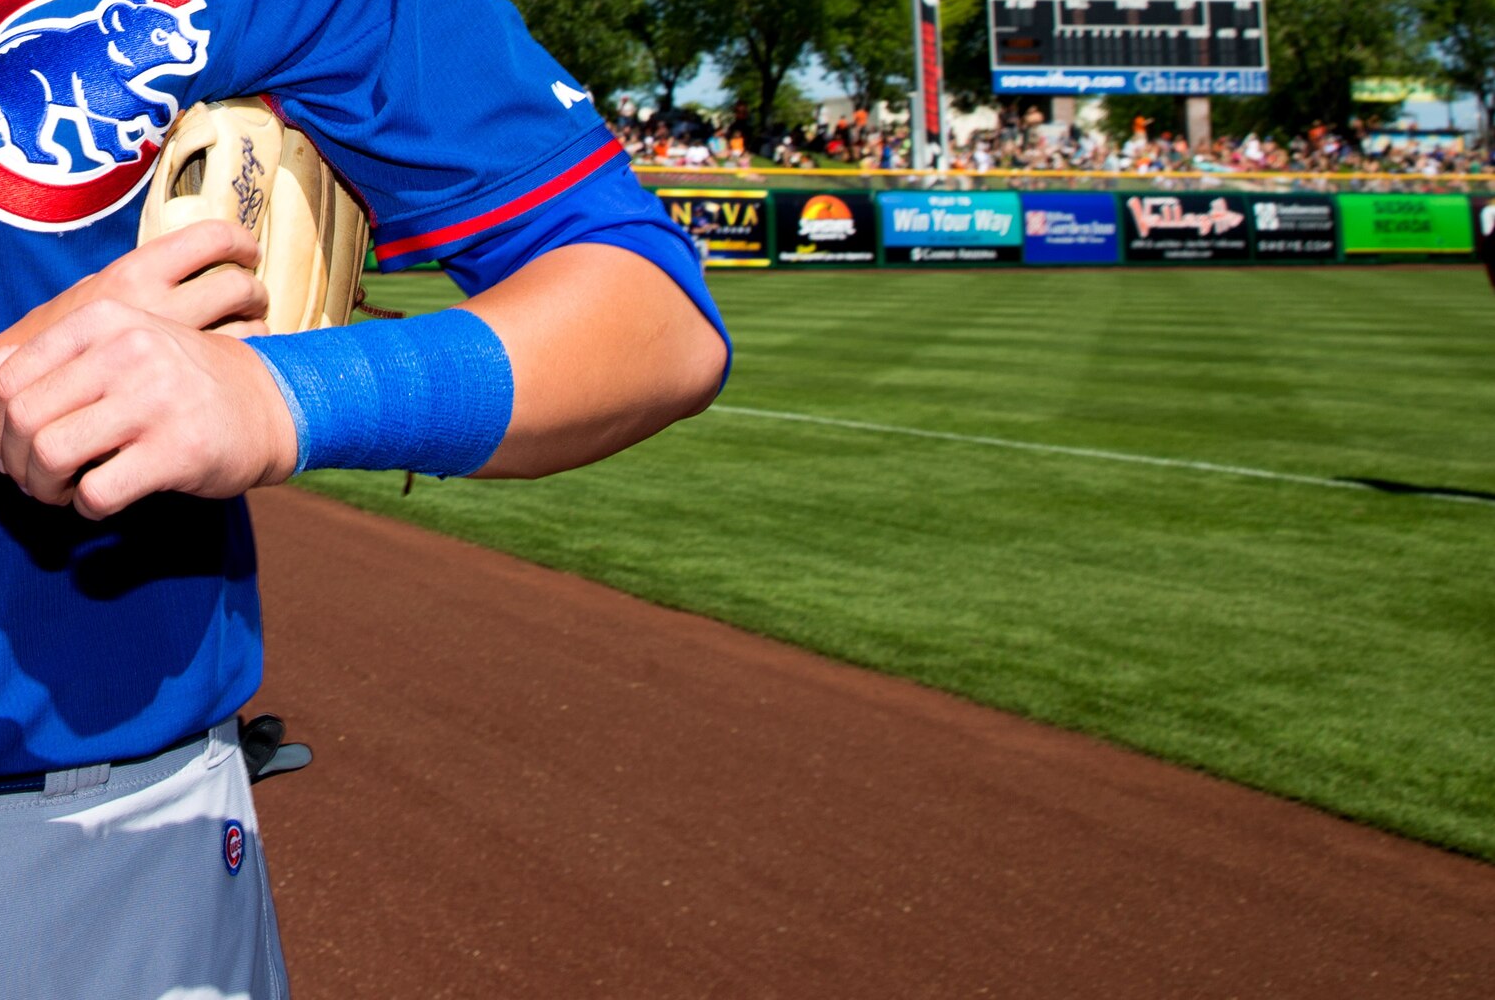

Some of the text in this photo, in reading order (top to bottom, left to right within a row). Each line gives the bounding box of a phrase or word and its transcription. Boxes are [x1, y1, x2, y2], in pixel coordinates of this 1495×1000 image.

[1133, 70, 1266, 93] Ghirardelli
[893, 208, 1013, 236] Win Your Way
